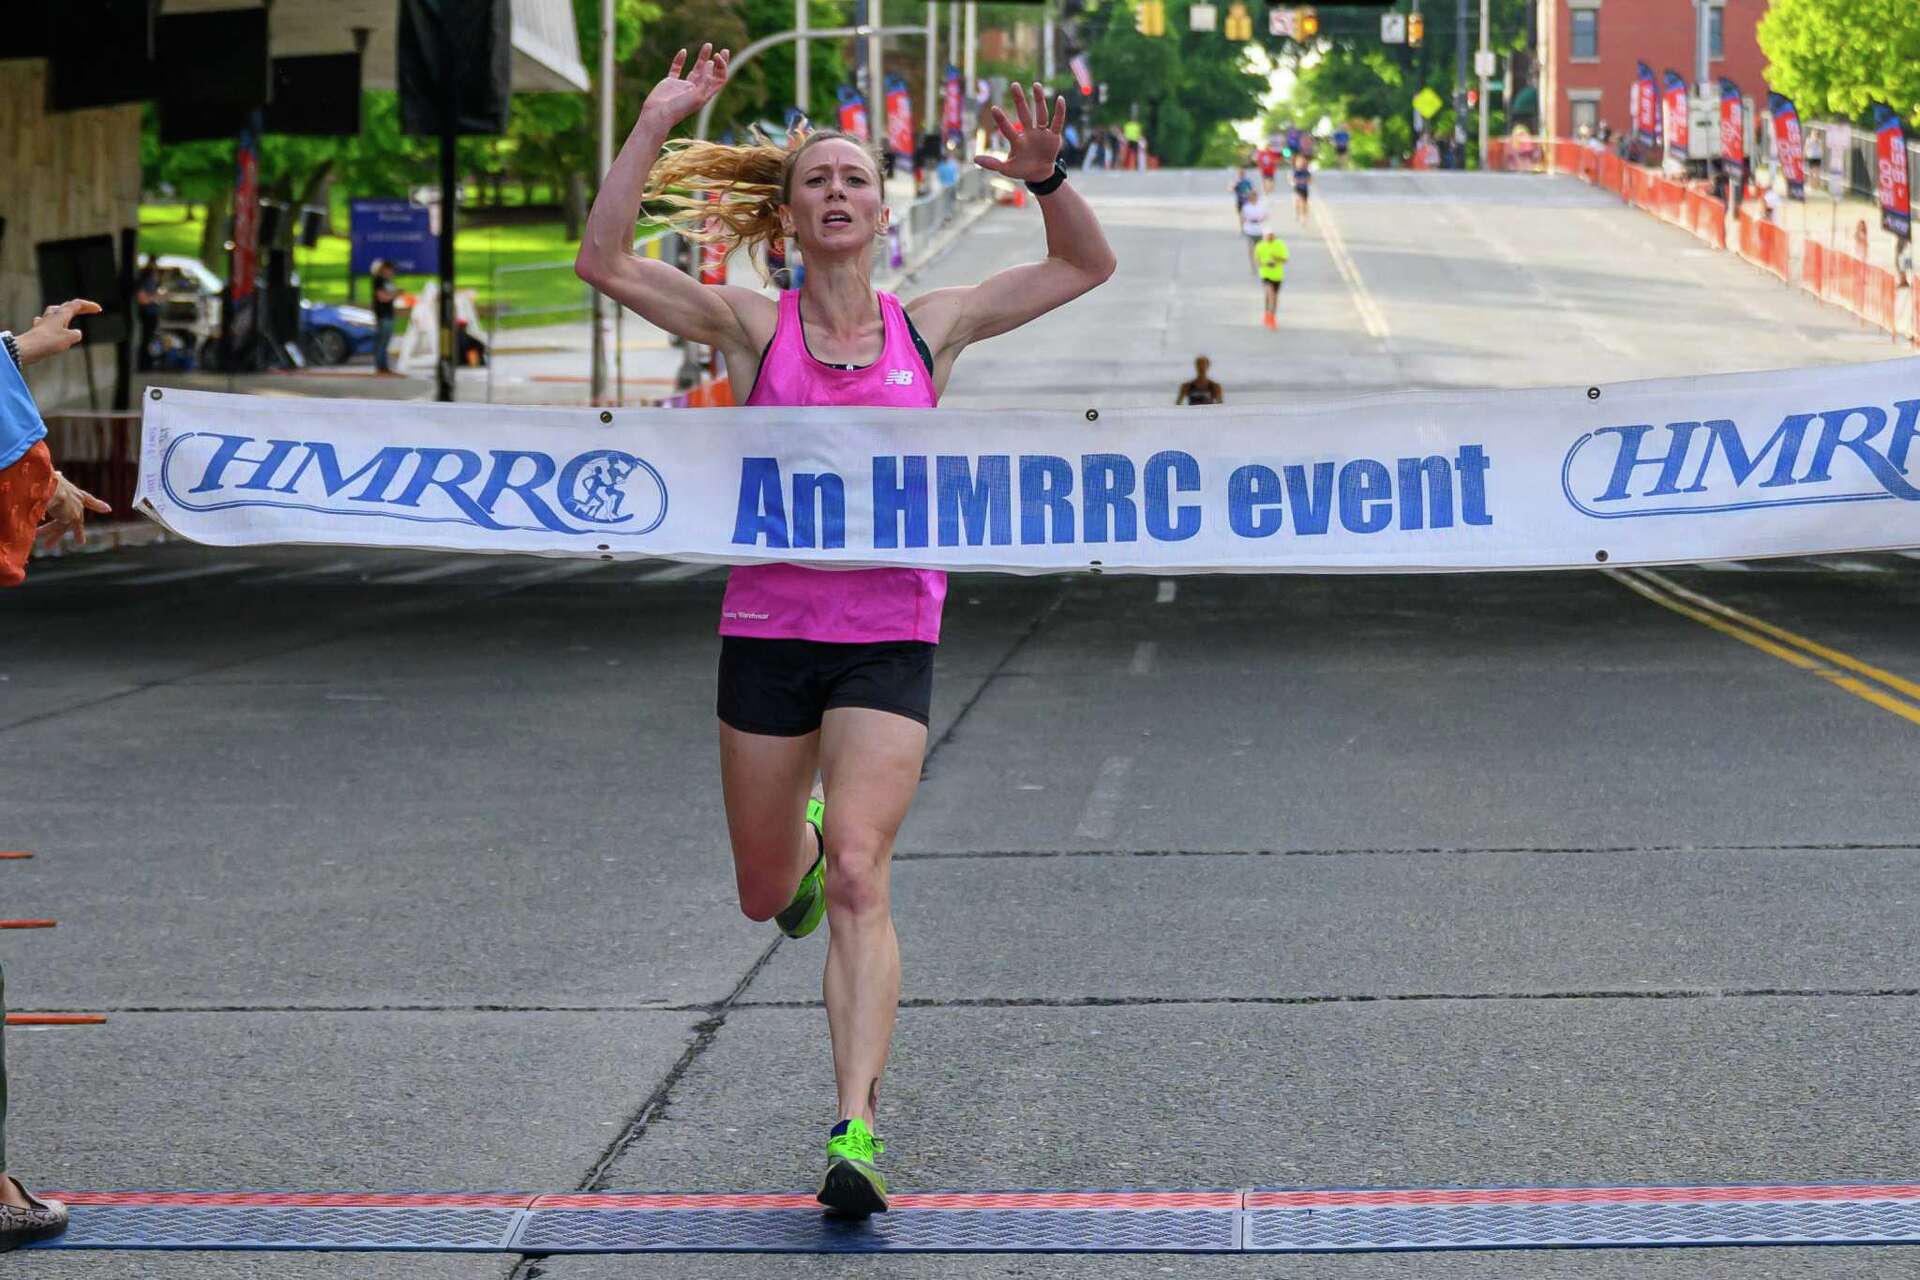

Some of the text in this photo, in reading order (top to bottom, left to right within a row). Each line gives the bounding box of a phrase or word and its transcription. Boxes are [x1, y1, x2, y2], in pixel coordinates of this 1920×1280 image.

[188, 432, 638, 535] HMRRC
[731, 444, 1494, 549] An HMRRC event
